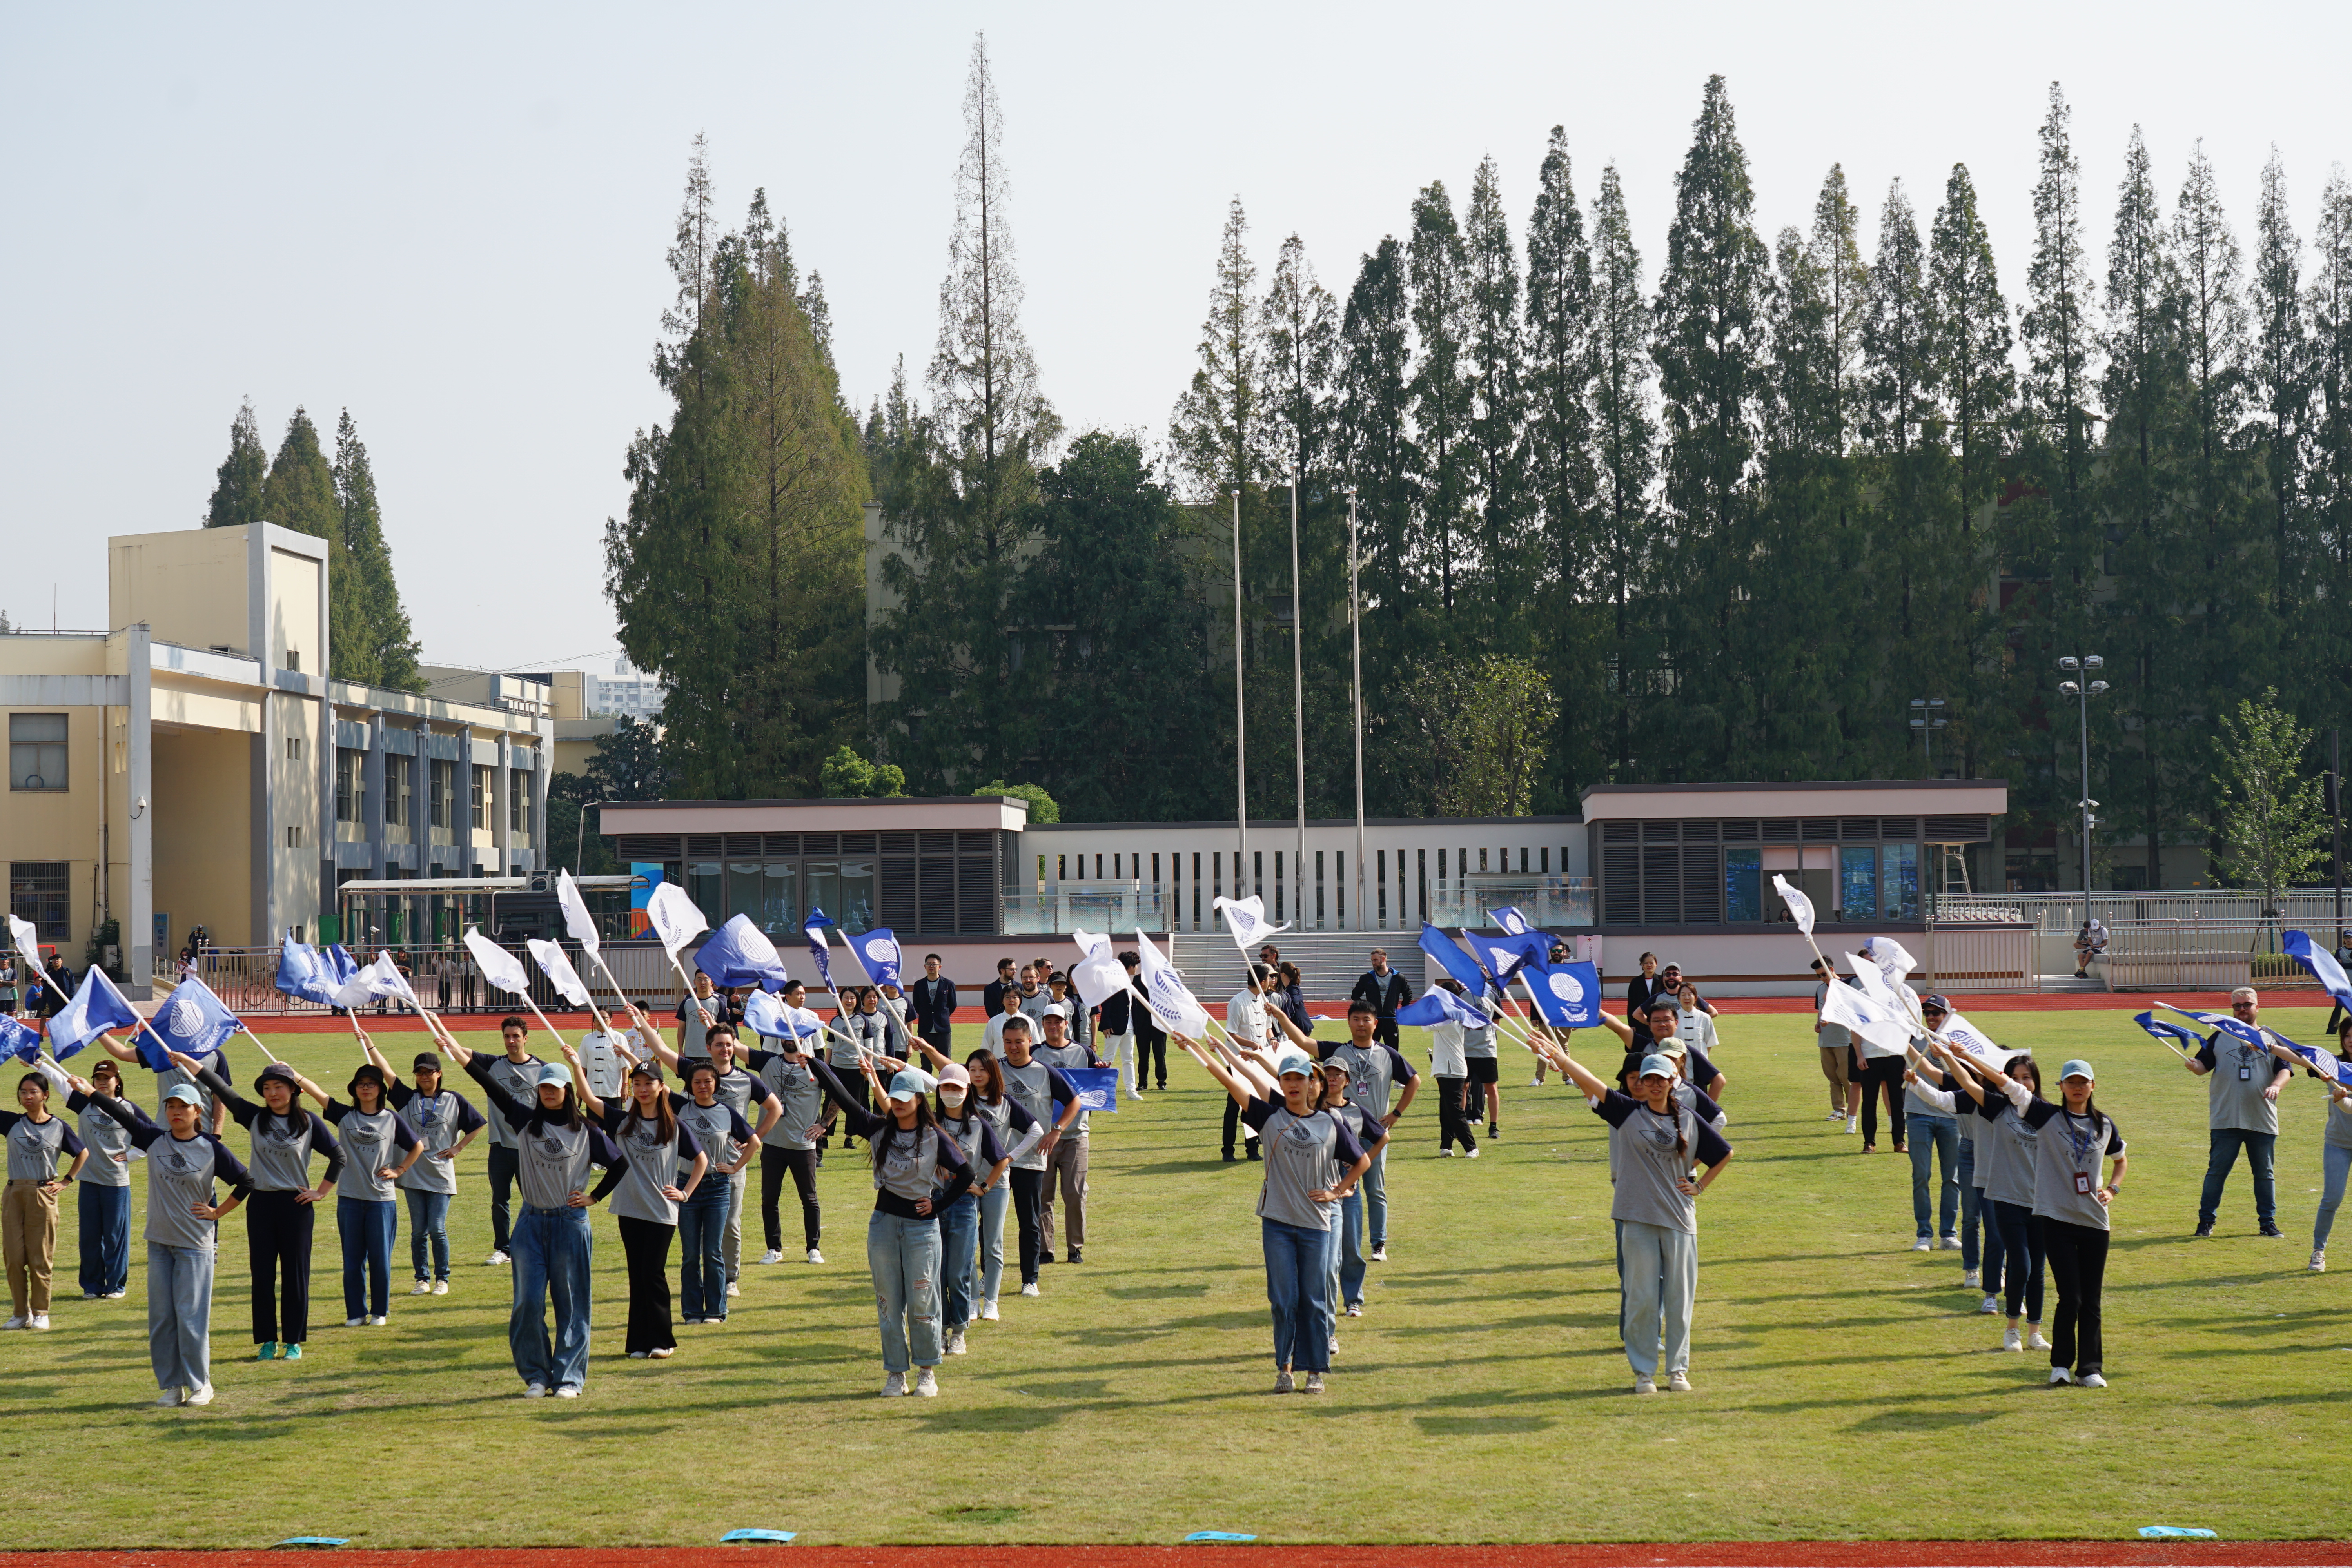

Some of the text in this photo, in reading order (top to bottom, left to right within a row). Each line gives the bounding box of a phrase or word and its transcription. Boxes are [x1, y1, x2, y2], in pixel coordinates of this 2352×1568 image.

[1152, 992, 1168, 1004] DIVISION
[777, 1089, 797, 1098] SSID
[263, 1148, 288, 1158] SHSID
[1283, 1147, 1310, 1158] SHSID
[2065, 1151, 2092, 1164] SHID
[535, 1160, 562, 1171] SHSID
[160, 1174, 185, 1185] SHSID
